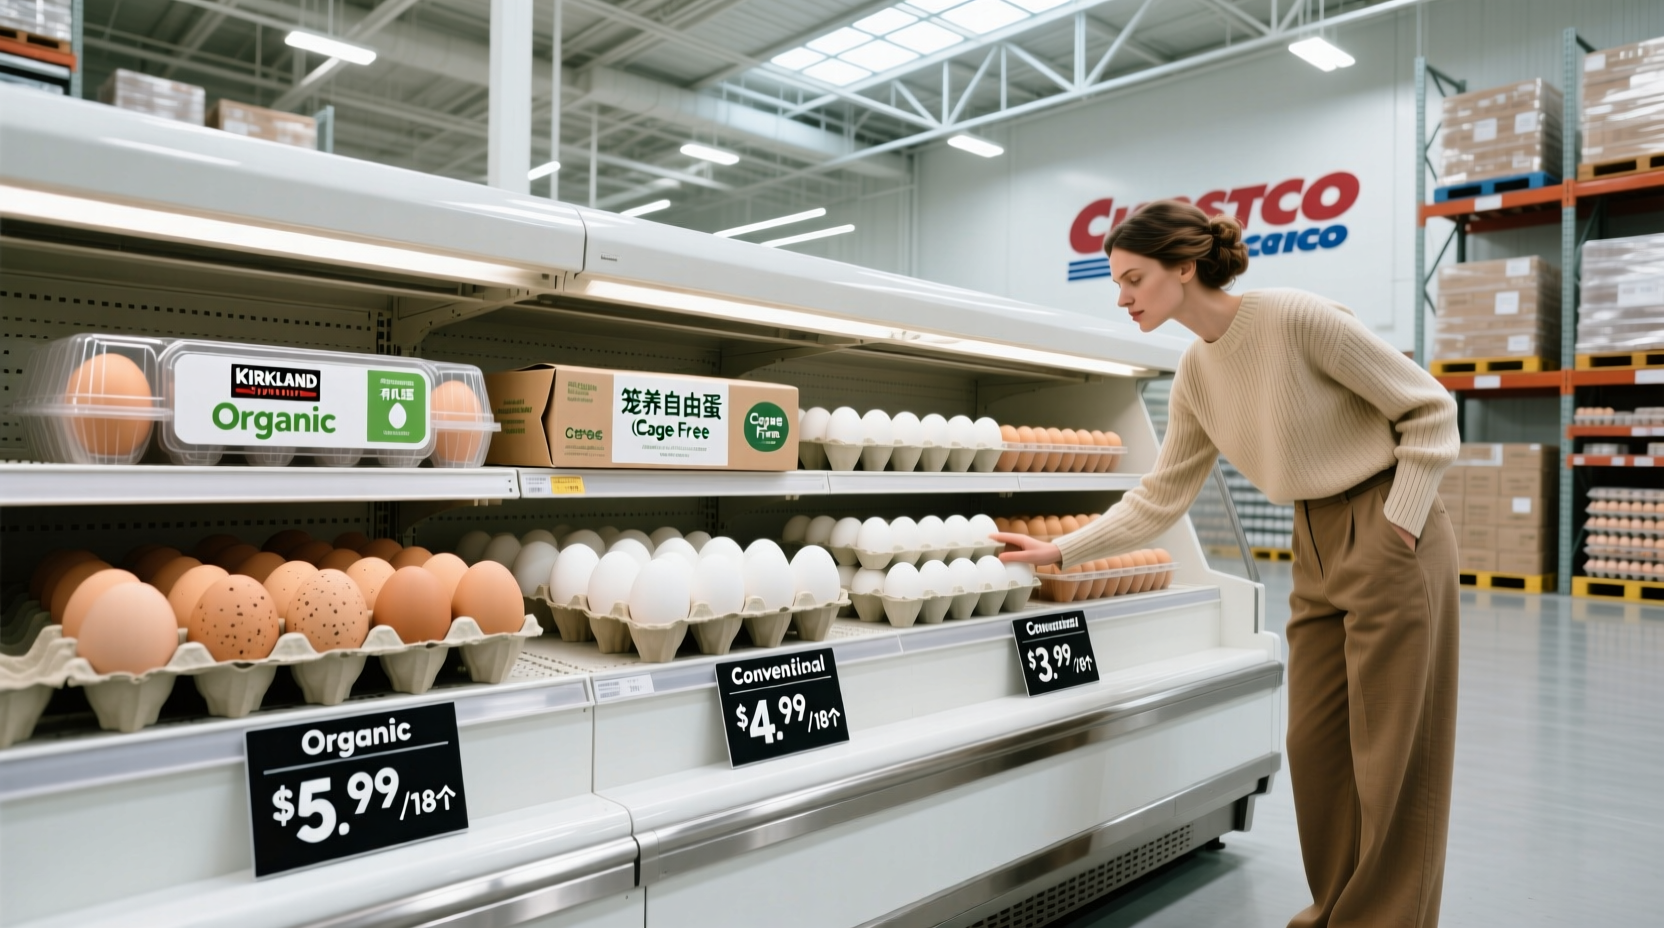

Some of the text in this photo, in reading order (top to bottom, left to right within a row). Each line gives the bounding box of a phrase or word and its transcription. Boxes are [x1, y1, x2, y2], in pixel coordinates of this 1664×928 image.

[235, 367, 318, 389] KIRKLAND
[621, 387, 722, 420] 笼养自由蛋
[211, 401, 336, 440] Organic
[678, 421, 710, 440] Free
[301, 717, 412, 758] Organic
